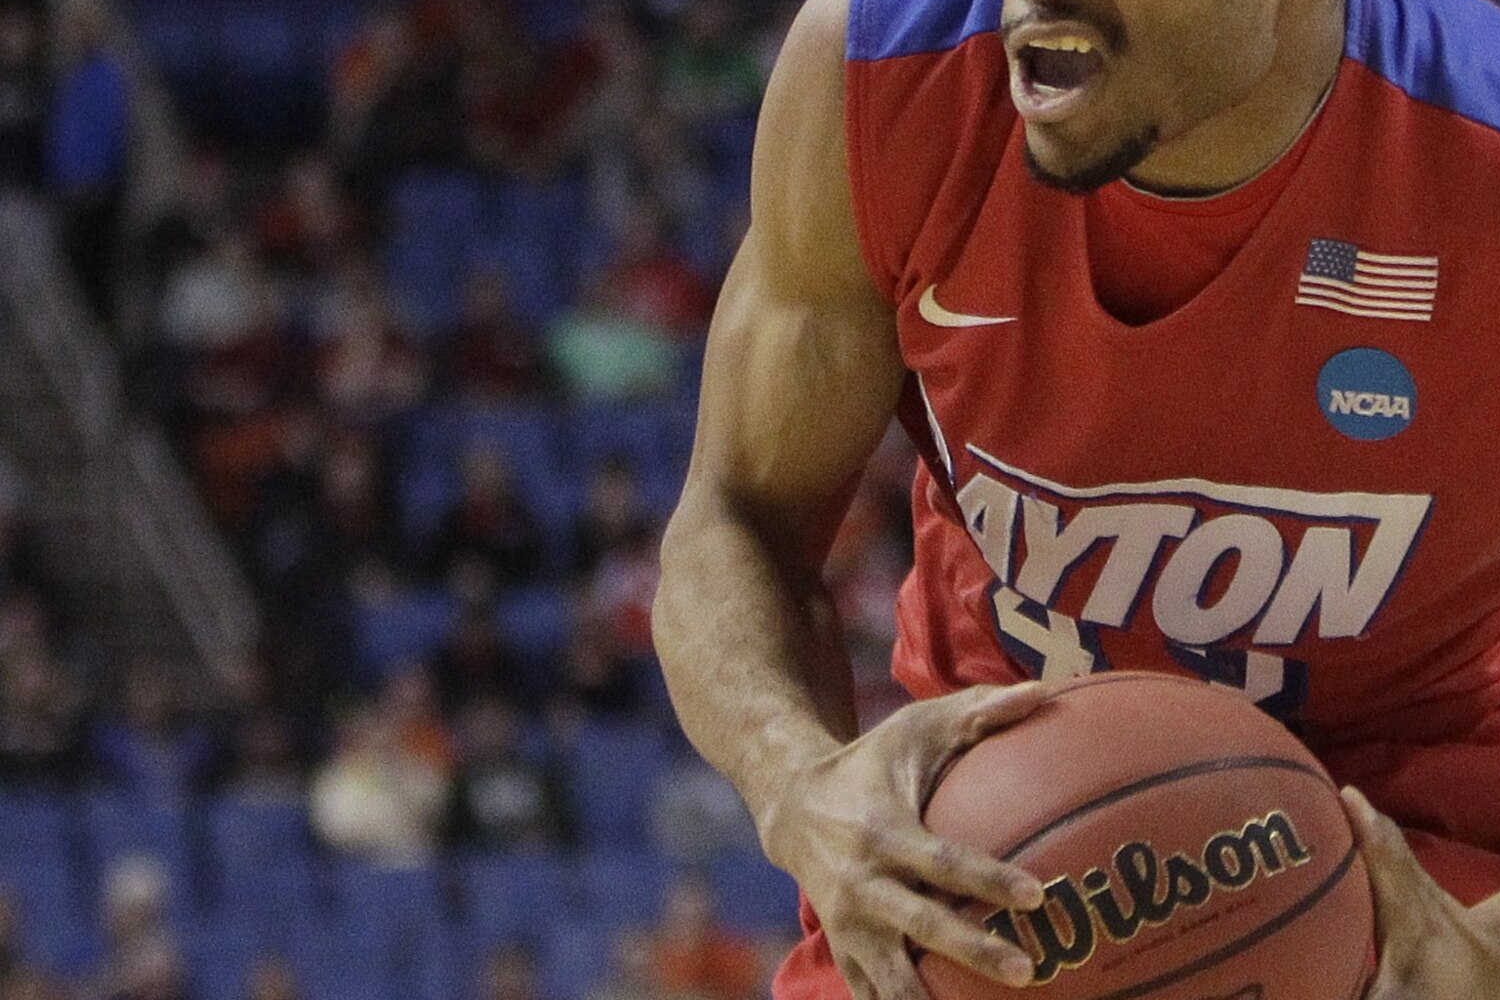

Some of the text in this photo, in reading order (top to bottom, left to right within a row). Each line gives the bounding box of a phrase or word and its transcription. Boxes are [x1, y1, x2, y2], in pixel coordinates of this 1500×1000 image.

[1329, 389, 1410, 420] NCAA
[956, 443, 1434, 646] AYTON
[983, 809, 1312, 987] Wilson
